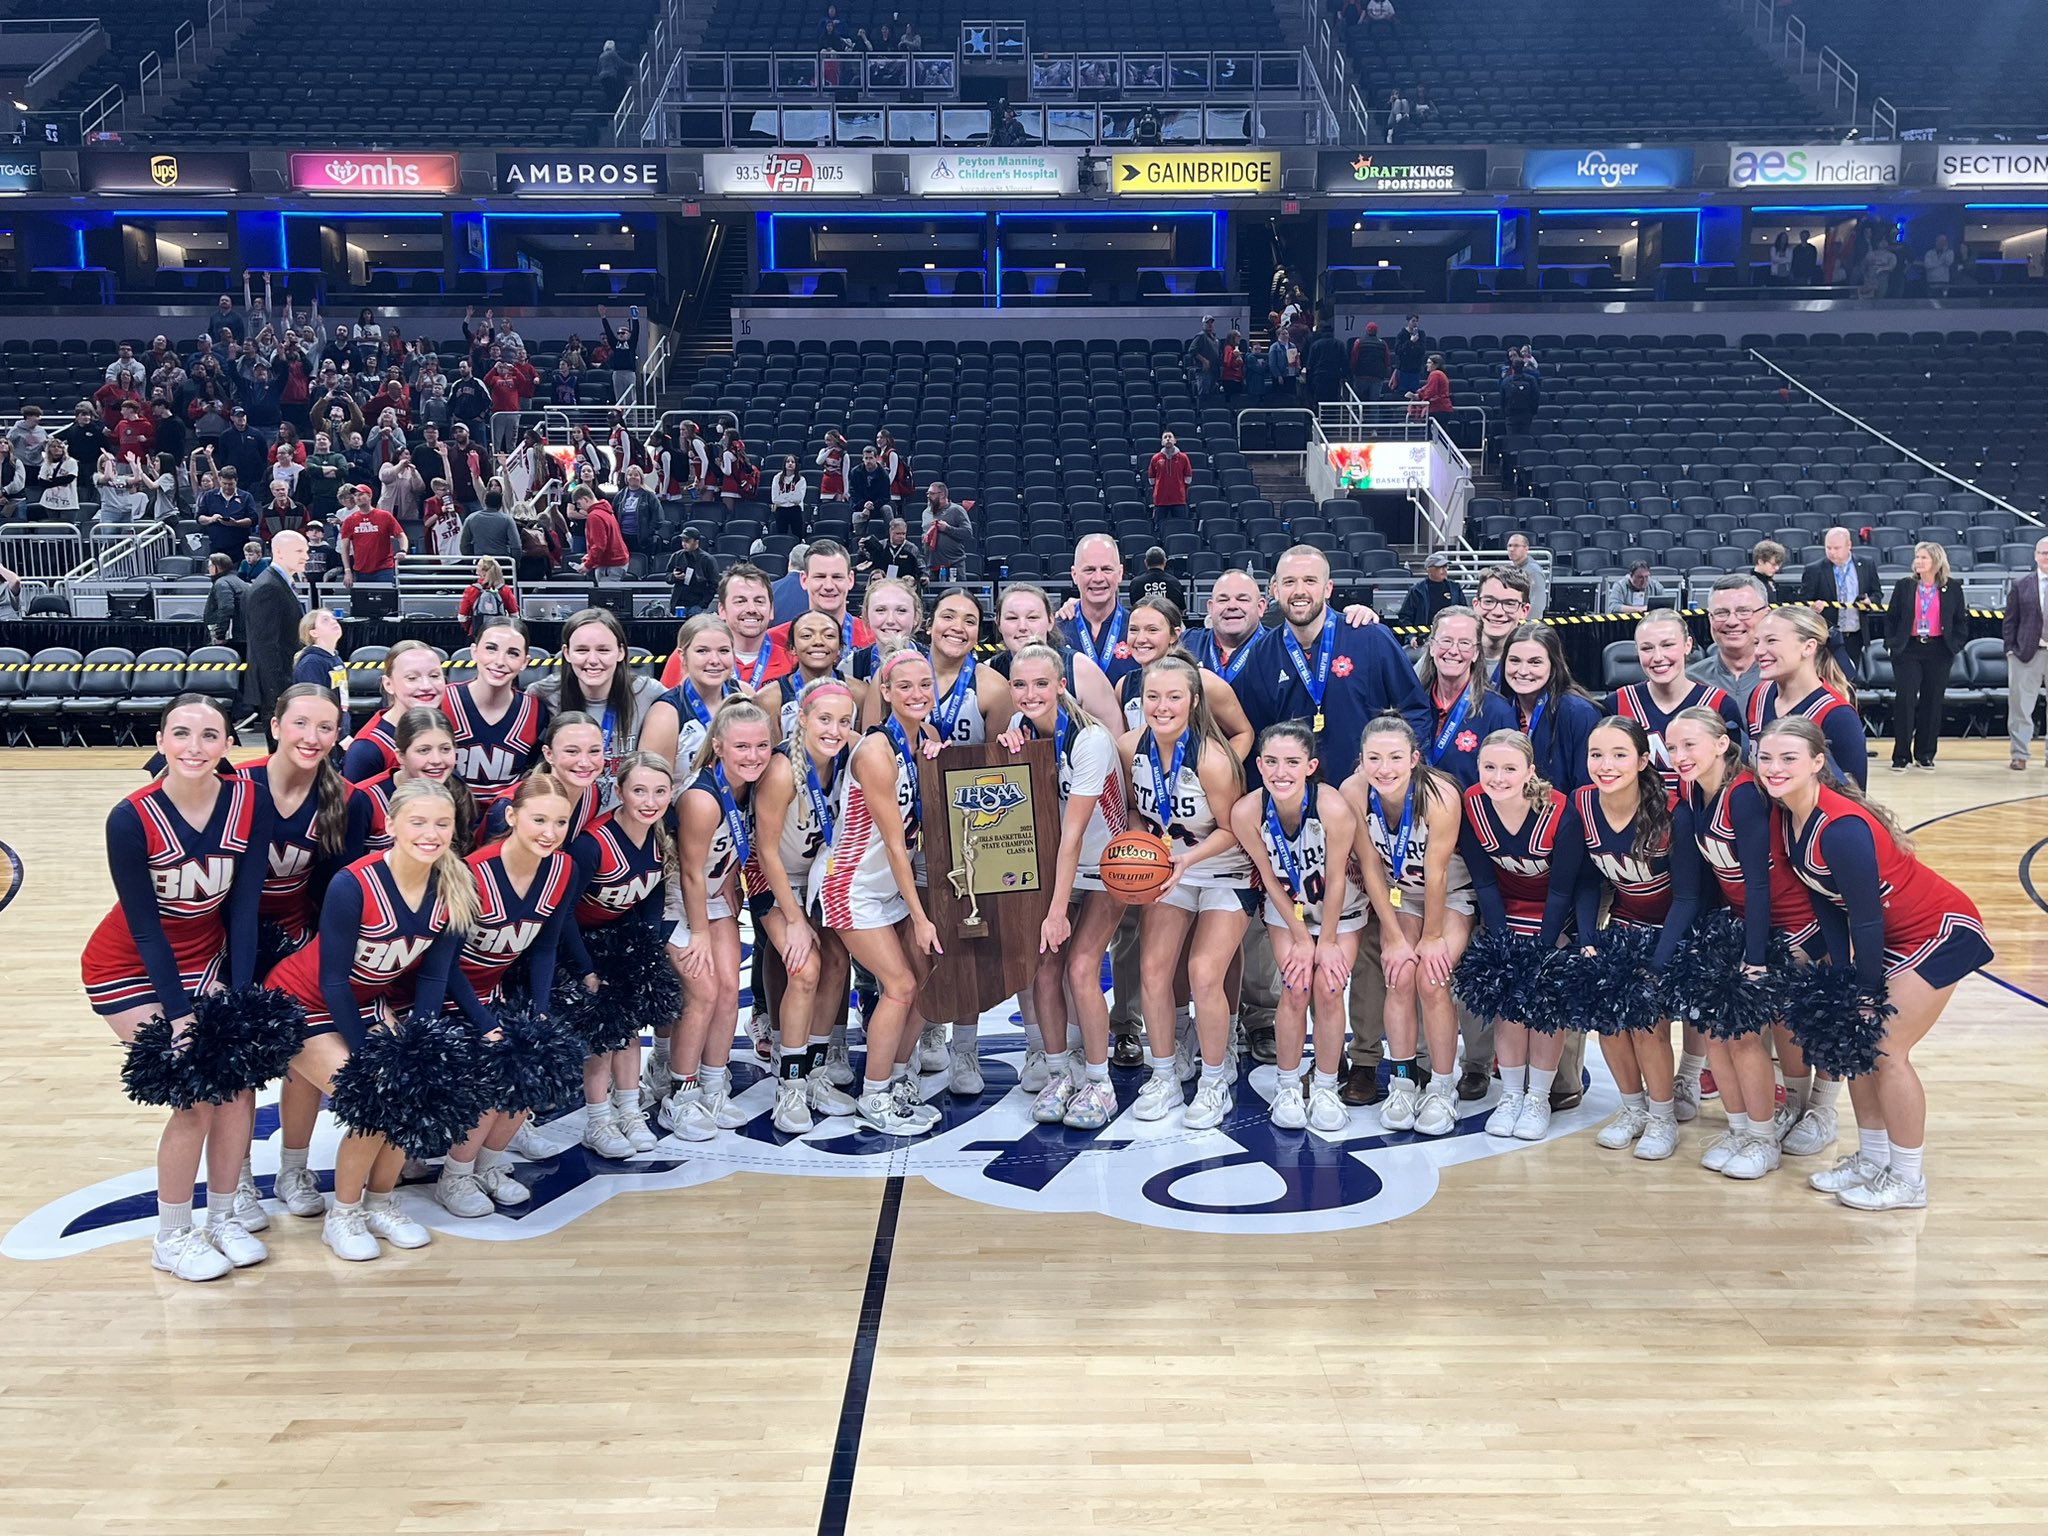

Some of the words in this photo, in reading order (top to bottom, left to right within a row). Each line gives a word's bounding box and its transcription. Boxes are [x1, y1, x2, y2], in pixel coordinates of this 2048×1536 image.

[361, 157, 420, 186] mhs
[762, 154, 802, 174] the
[958, 156, 994, 168] Peyton
[998, 156, 1045, 168] Manning
[1576, 151, 1639, 187] Kroger
[1733, 150, 1808, 183] aes
[1816, 158, 1896, 182] Indiana
[1943, 156, 2048, 174] SECTION
[153, 164, 176, 182] ups
[506, 164, 658, 183] AMBROSE
[736, 166, 760, 180] 93.5
[772, 172, 814, 192] fan
[816, 166, 844, 180] 107.5
[958, 169, 1010, 179] Children's
[1013, 168, 1058, 180] Hospital
[1148, 161, 1272, 184] GAINBRIDGE
[1354, 165, 1455, 180] DRAFTKINGS
[1377, 178, 1453, 190] SPORTSBOOK
[741, 320, 751, 335] 16
[1345, 316, 1355, 331] 17
[1144, 582, 1167, 592] CSC
[1103, 634, 1116, 660] CHAMPION
[1292, 650, 1312, 684] BASKETBALL
[1318, 652, 1329, 682] CHAMPION
[946, 695, 961, 724] CHAMPION
[1436, 720, 1456, 749] CHAMPION
[1154, 766, 1166, 804] BASKETBALL
[812, 788, 828, 826] BASKETBALL
[954, 784, 1025, 810] IHSAA
[728, 810, 745, 846] BASKETBALL
[994, 832, 1033, 840] BASKETBALL
[1001, 839, 1034, 848] CHAMPION
[1396, 826, 1409, 857] CHAMPION
[1695, 834, 1741, 868] NL
[268, 842, 312, 876] NL
[1108, 844, 1158, 862] Wilson
[1275, 834, 1292, 872] BASKETBALL
[1108, 872, 1154, 880] EVOLUTION
